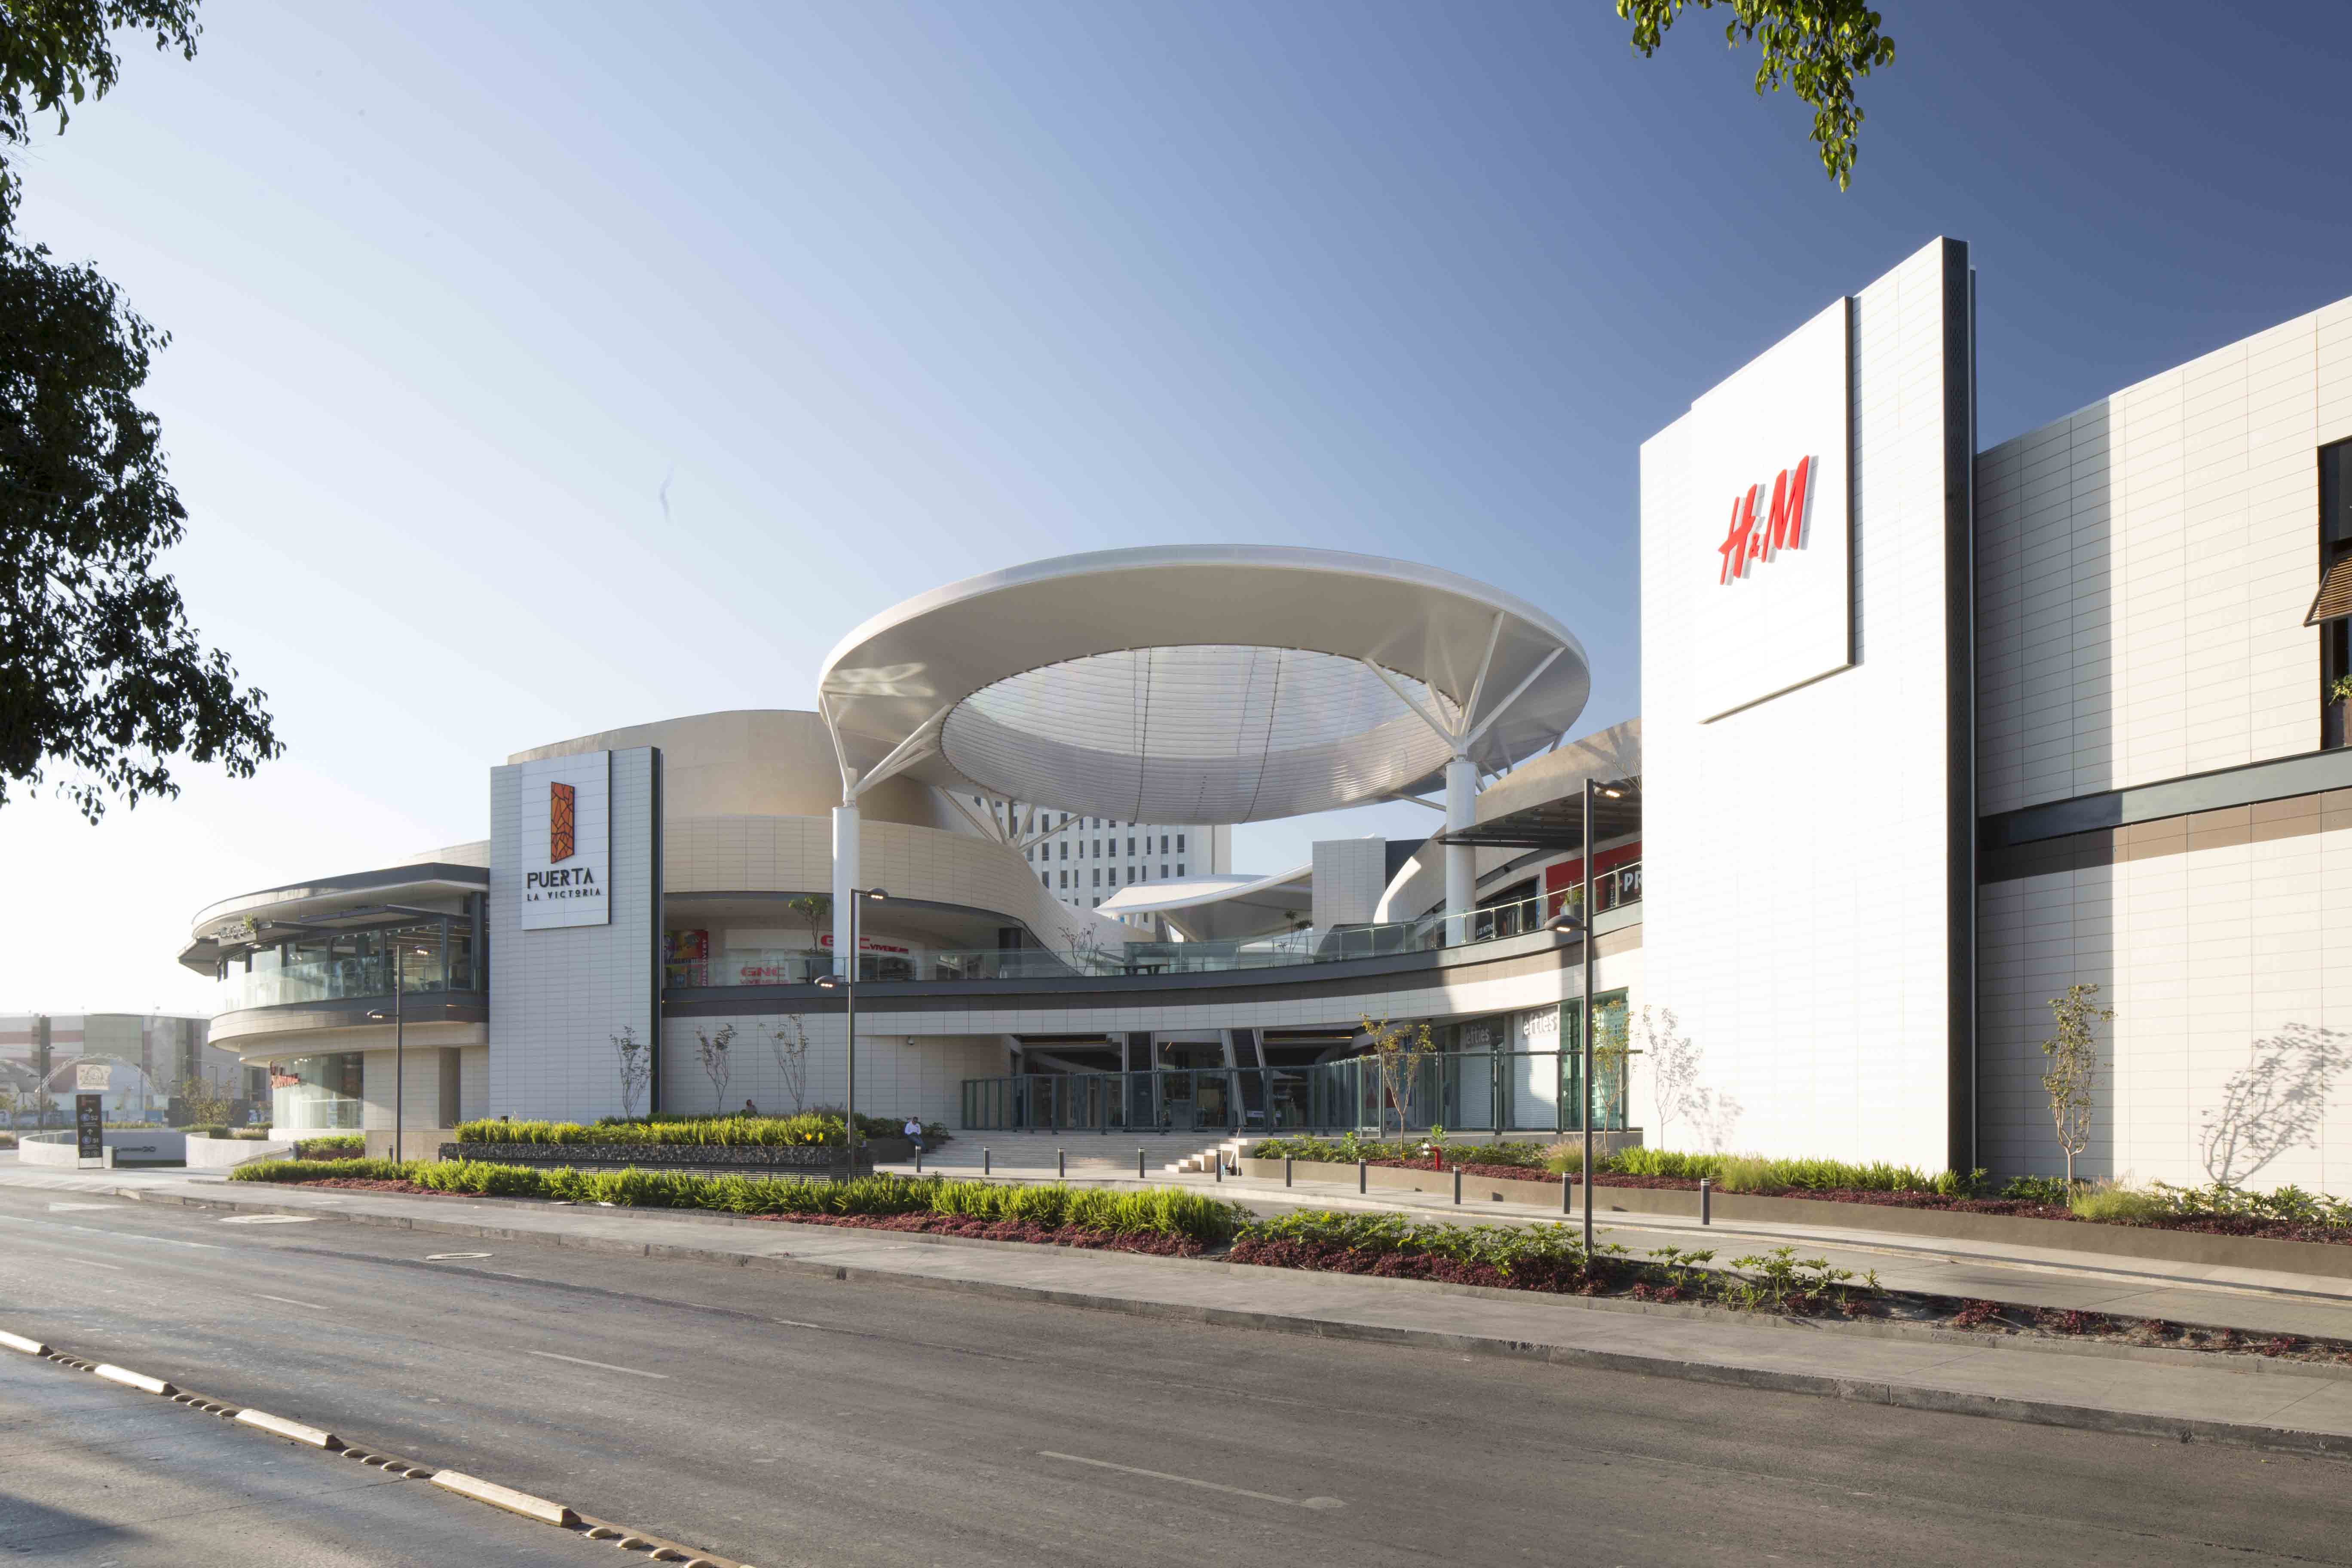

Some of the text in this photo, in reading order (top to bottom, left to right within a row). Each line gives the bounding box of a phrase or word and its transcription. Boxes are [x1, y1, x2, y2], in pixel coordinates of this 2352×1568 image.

[1718, 455, 1810, 585] H&M
[527, 867, 594, 889] PUERTA
[547, 887, 601, 899] VICTORIA
[740, 967, 785, 977] GNC
